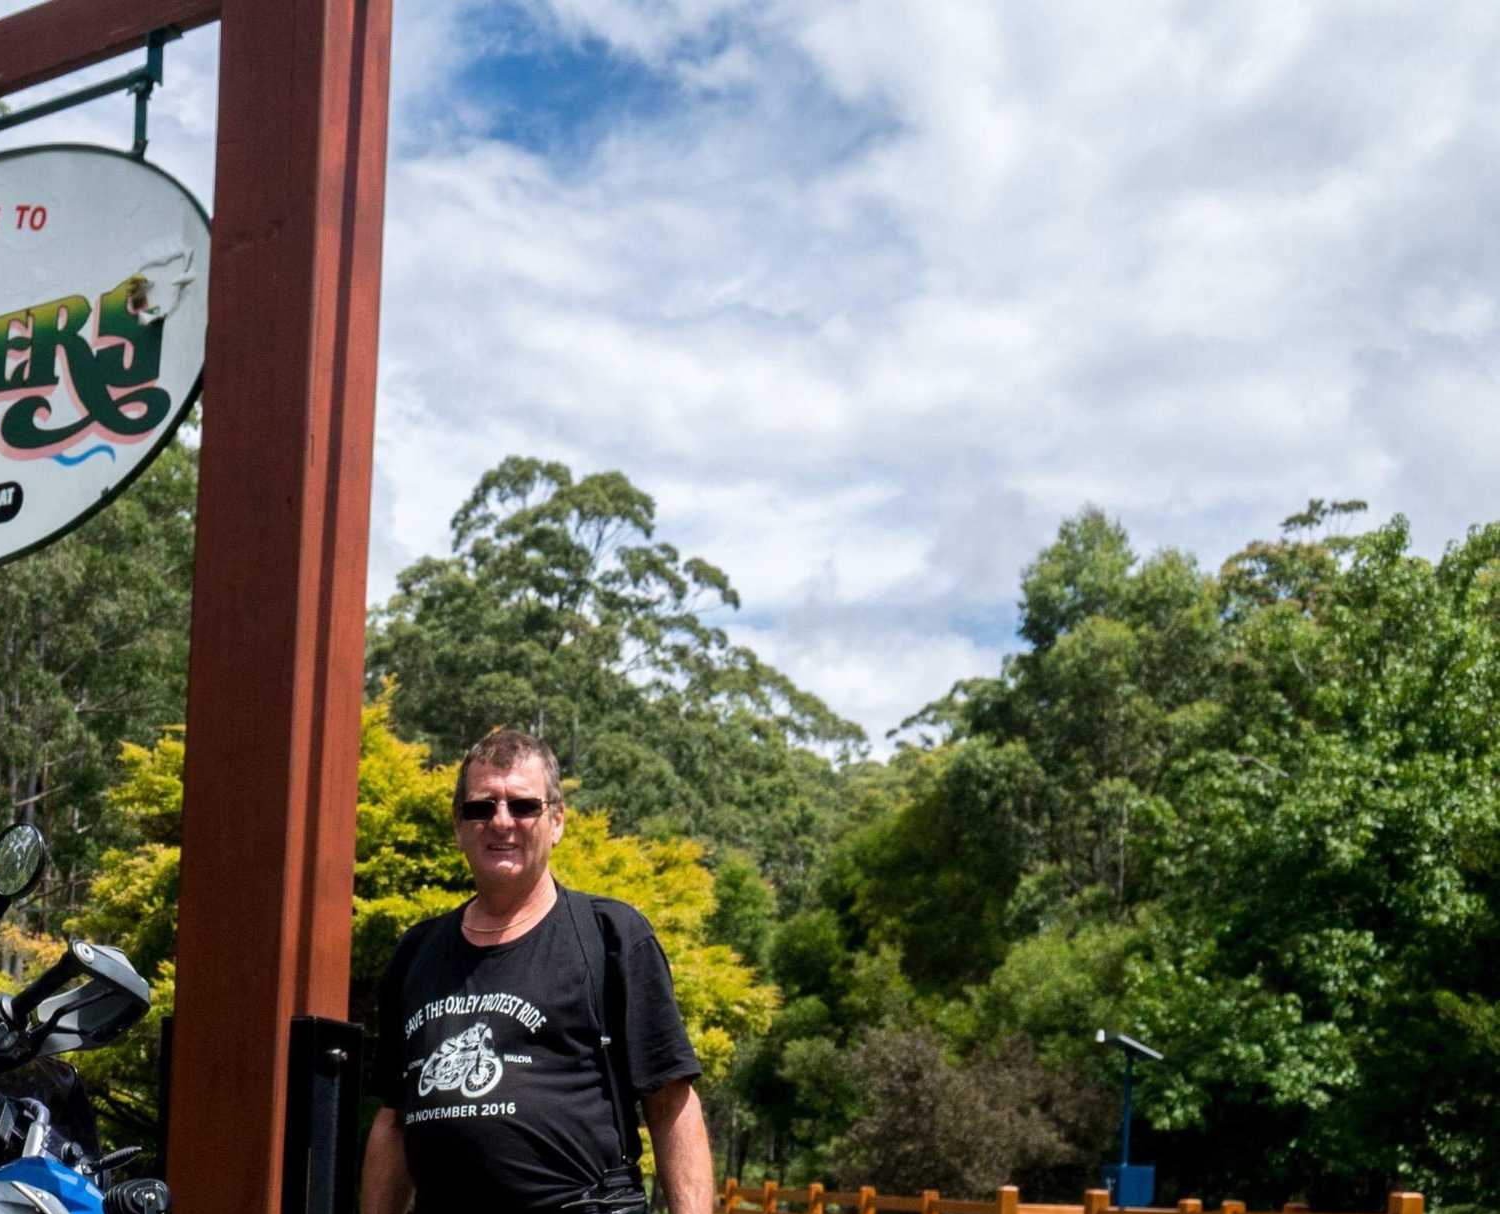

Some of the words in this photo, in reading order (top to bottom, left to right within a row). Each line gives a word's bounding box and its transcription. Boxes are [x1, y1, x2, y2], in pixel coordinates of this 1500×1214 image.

[15, 205, 47, 231] TO
[404, 1008, 425, 1040] SAVE
[424, 999, 446, 1020] THE
[445, 995, 481, 1015] OXLEY
[477, 992, 524, 1017] PROTEST
[515, 1001, 548, 1034] RIDE
[415, 1104, 478, 1122] NOVEMBER
[480, 1102, 517, 1116] 2016
